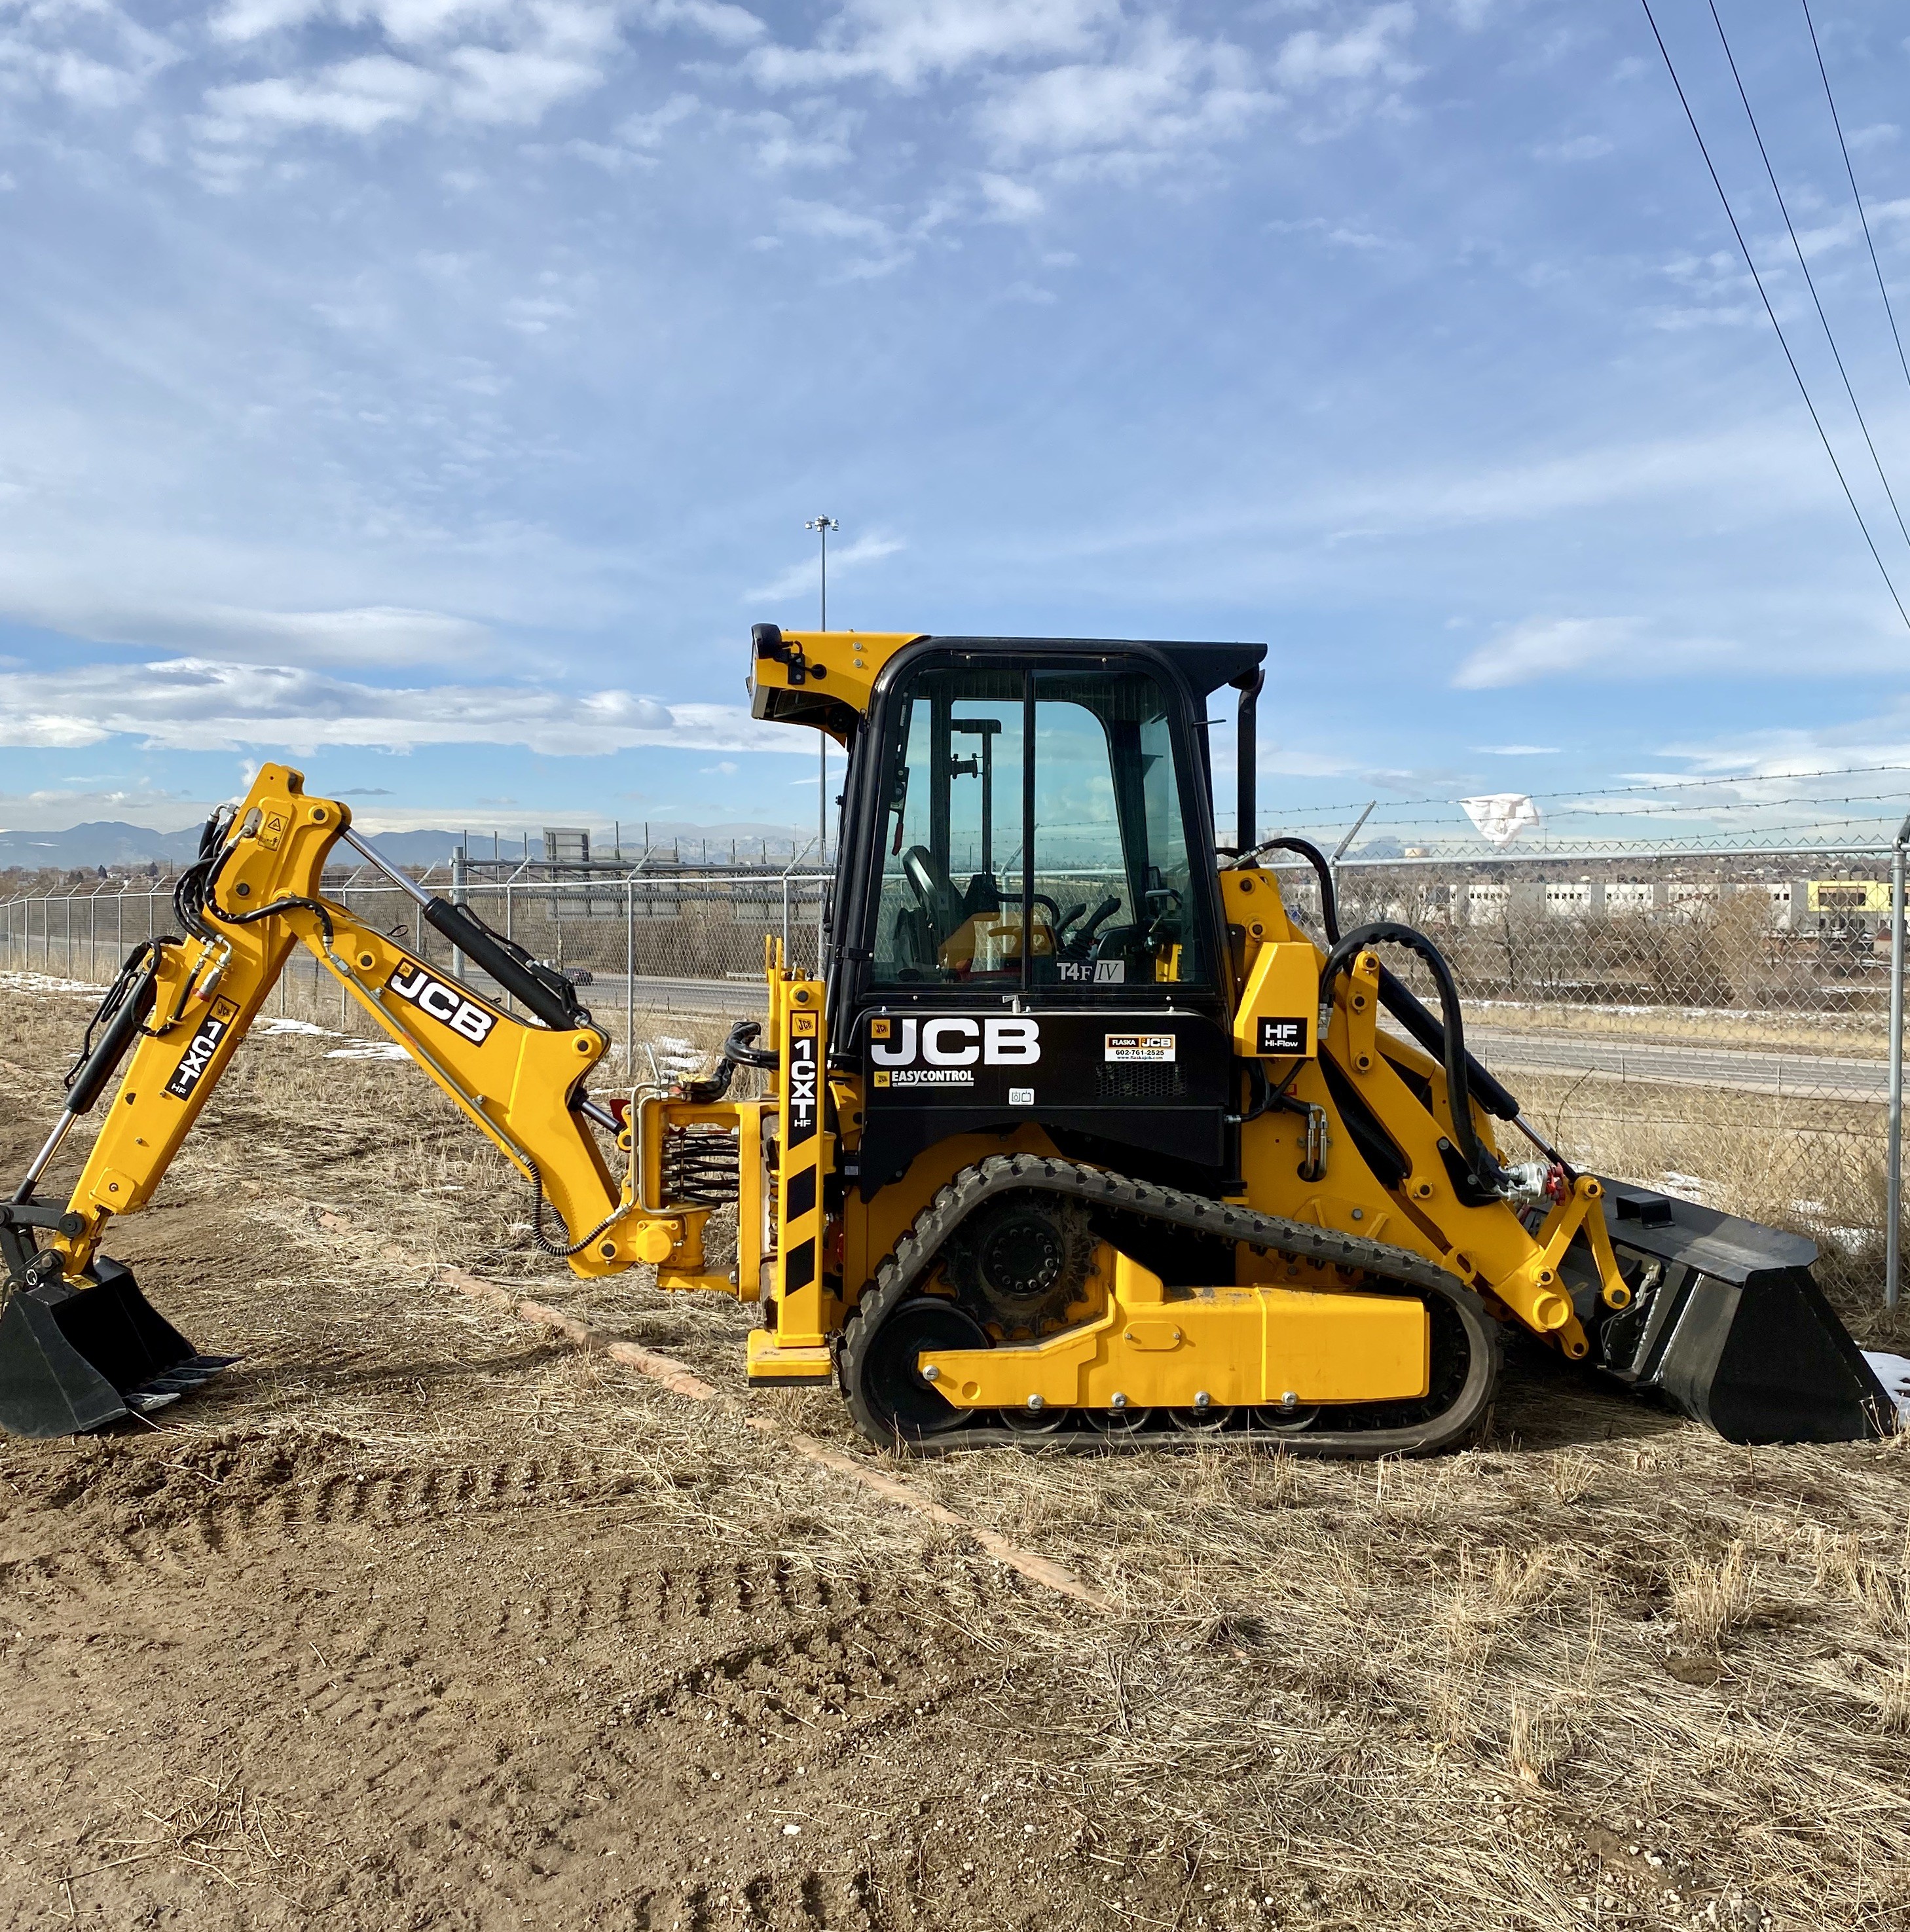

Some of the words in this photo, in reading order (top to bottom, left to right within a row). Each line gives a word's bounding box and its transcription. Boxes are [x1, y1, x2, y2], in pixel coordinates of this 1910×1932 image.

[1095, 963, 1120, 981] IV
[390, 972, 492, 1042] JCB
[798, 1019, 813, 1030] JCB
[1265, 1024, 1298, 1039] HF
[871, 1018, 1041, 1065] JCB
[1141, 1038, 1171, 1048] JCB
[178, 1021, 223, 1086] 1CXT
[790, 1039, 816, 1119] 1CXT
[171, 1083, 187, 1095] HF
